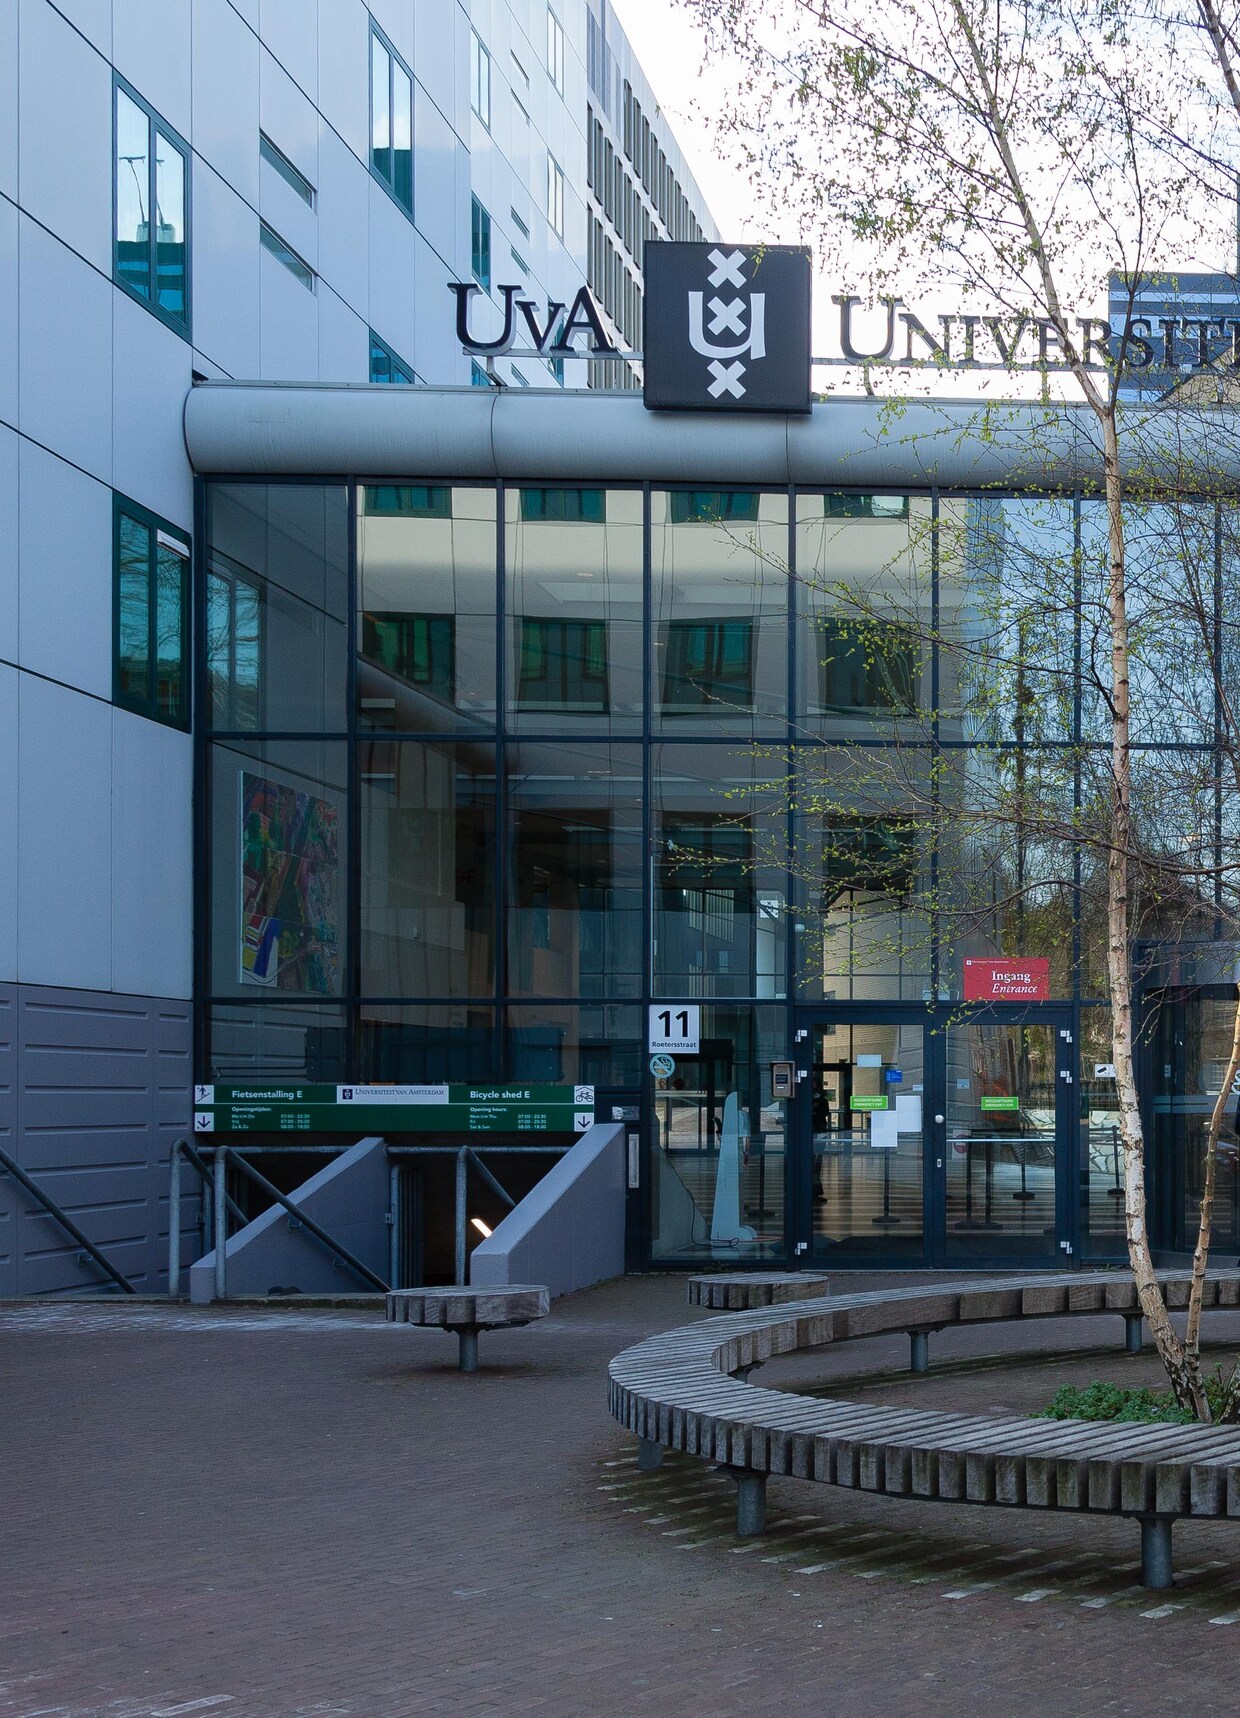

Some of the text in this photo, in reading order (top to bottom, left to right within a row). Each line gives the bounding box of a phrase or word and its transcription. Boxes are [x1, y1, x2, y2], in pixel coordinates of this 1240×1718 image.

[992, 970, 1030, 983] Ingang
[992, 983, 1038, 993] Entrance
[658, 1011, 688, 1037] 11
[232, 1090, 294, 1100] Fietsenstalling
[470, 1091, 499, 1100] Bicycle
[501, 1090, 522, 1098] shed
